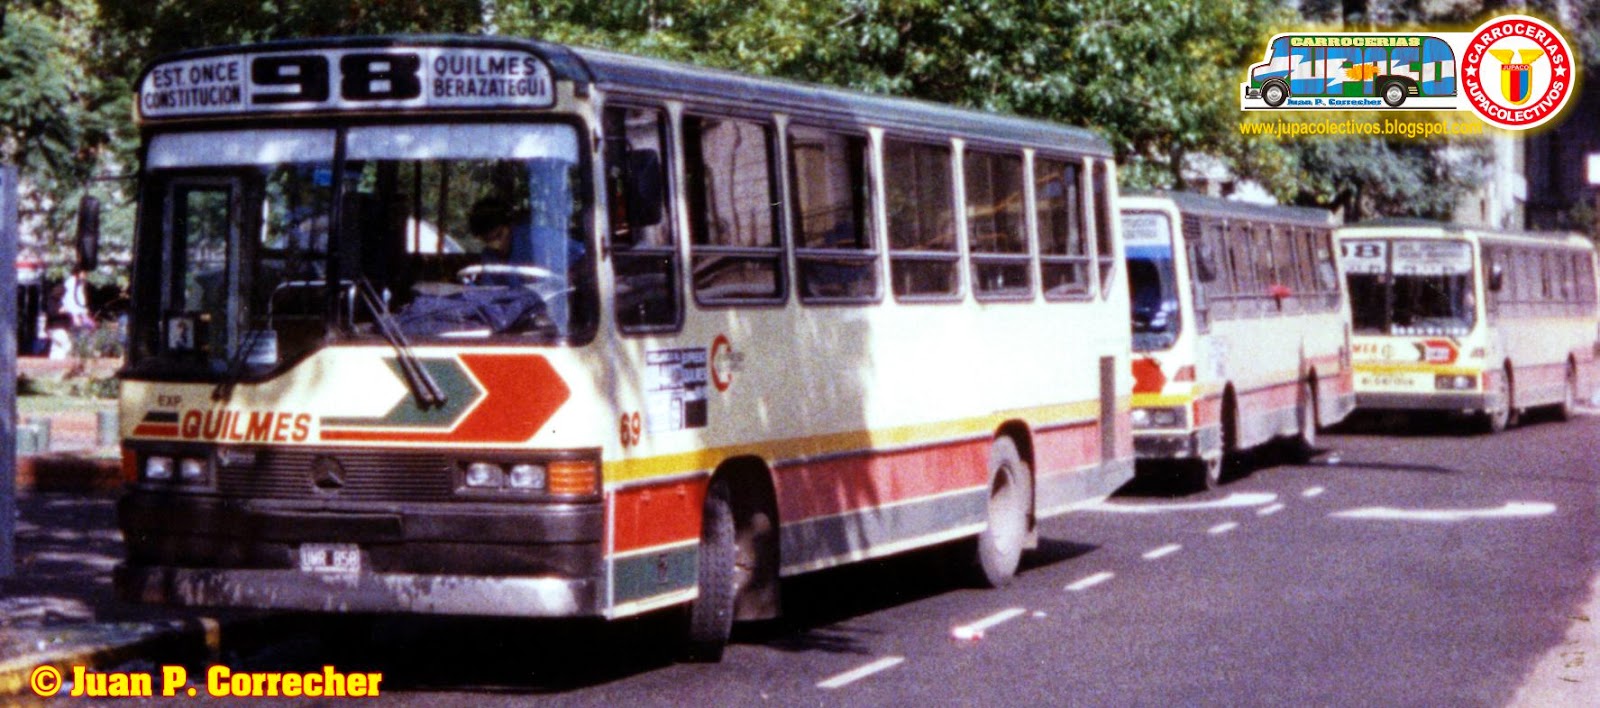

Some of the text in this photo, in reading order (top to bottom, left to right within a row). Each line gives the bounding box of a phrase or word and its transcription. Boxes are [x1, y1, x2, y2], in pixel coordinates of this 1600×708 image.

[190, 61, 239, 83] ONCE
[434, 56, 536, 76] QUILMES
[251, 53, 422, 104] 98
[433, 77, 545, 98] BERAZATEGUI
[145, 85, 242, 108] CONSTITUCION
[181, 409, 312, 442] QUILMES
[620, 411, 641, 448] 69
